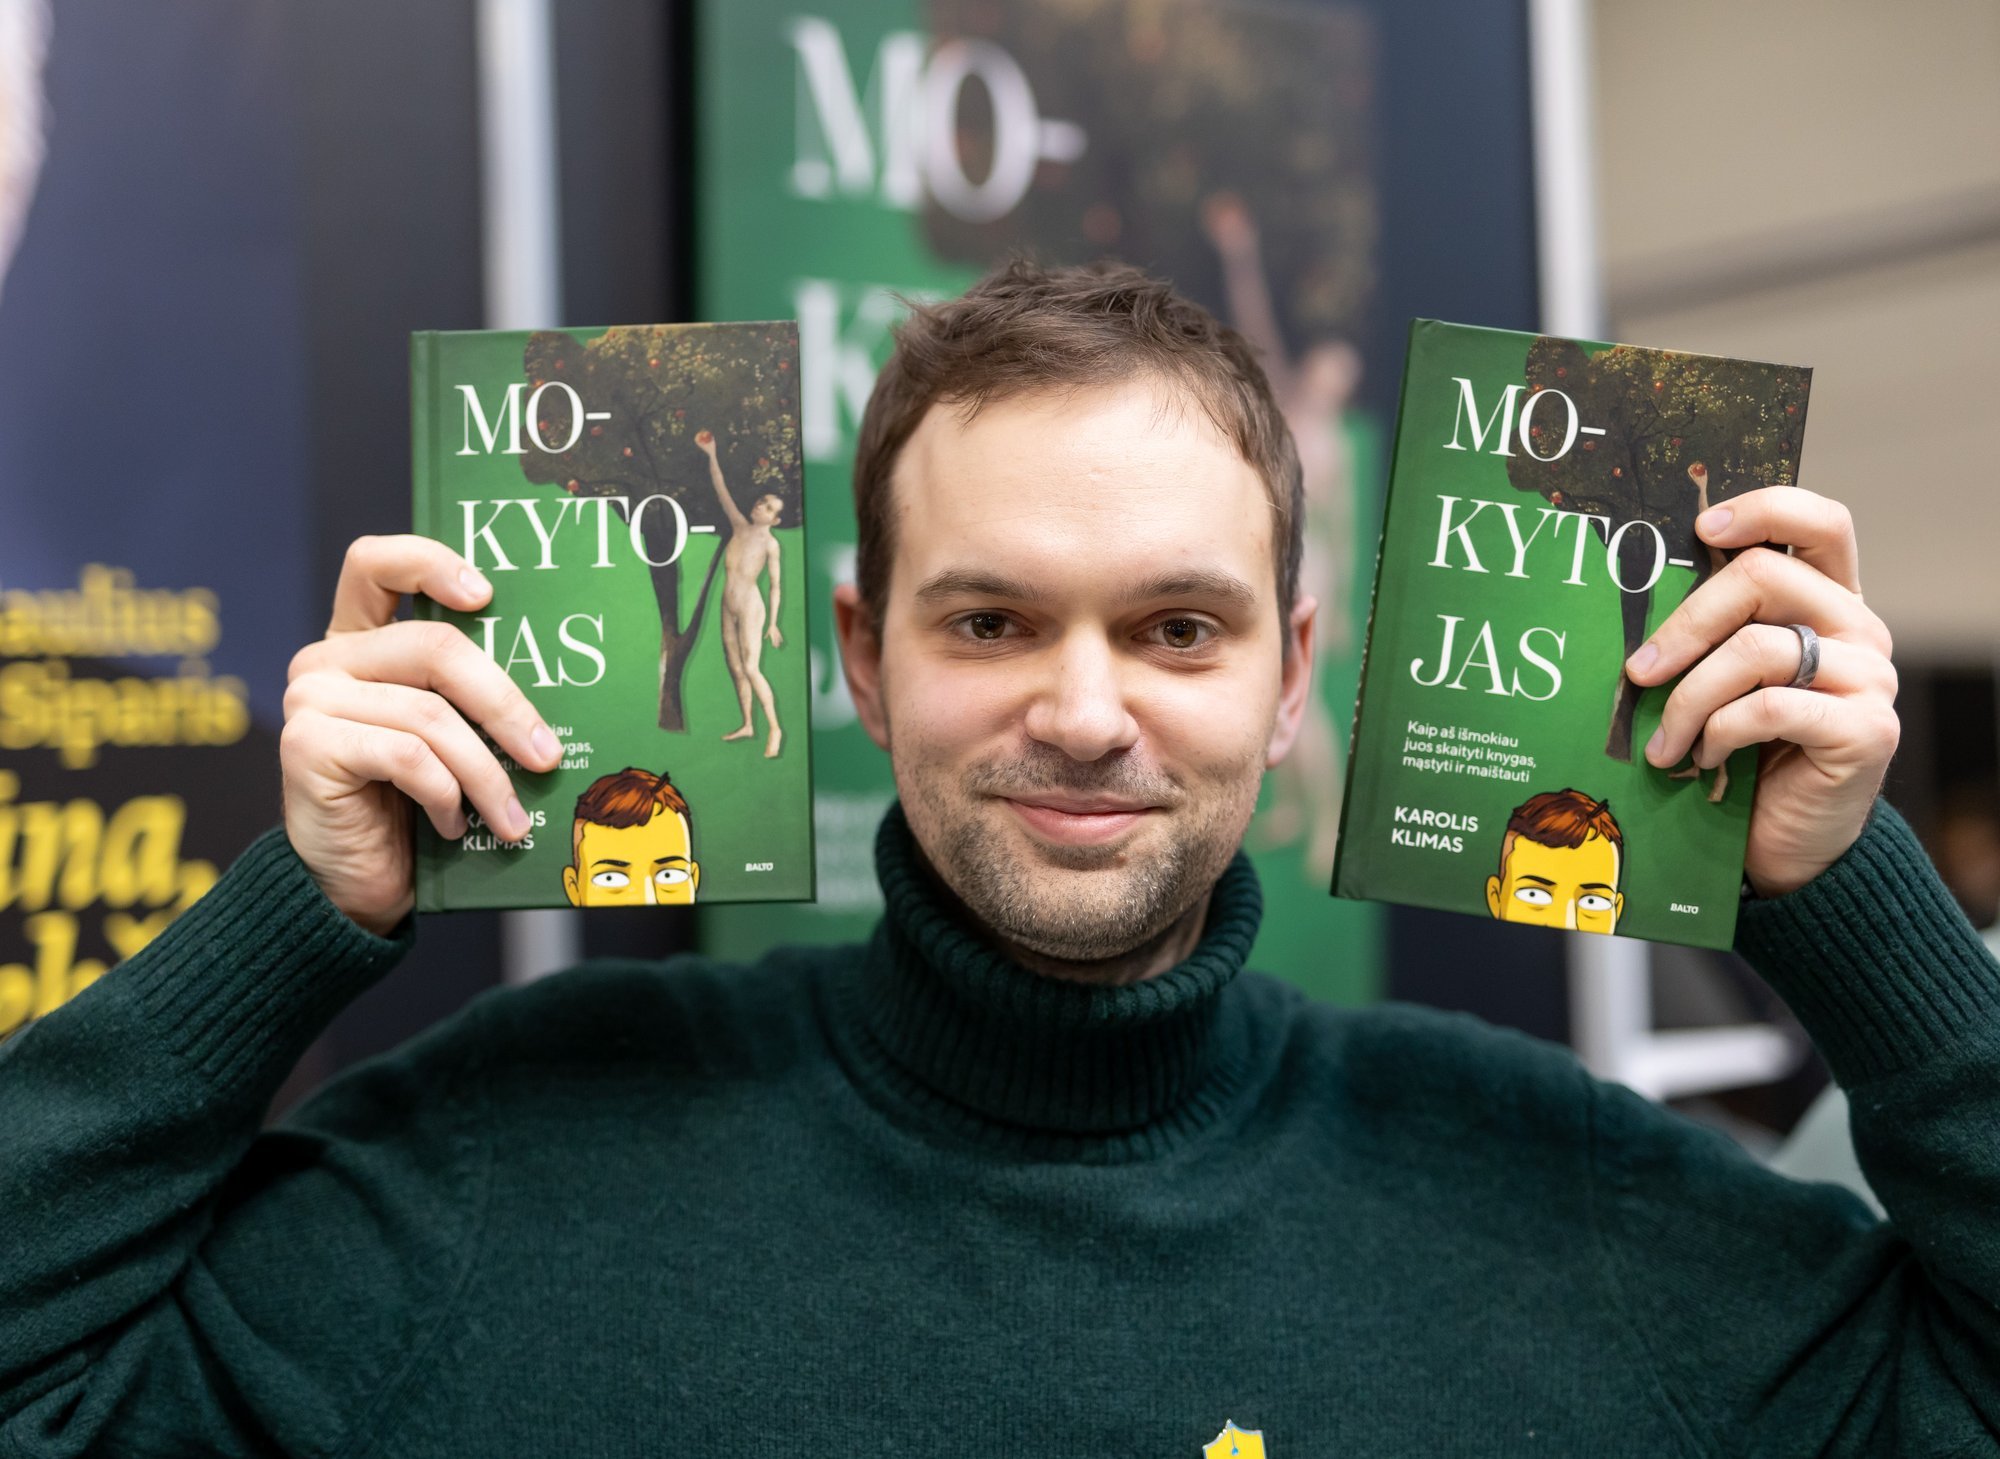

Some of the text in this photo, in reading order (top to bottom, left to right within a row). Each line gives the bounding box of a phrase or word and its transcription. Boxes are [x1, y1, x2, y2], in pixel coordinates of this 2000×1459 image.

[455, 381, 611, 456] MO-
[1442, 376, 1606, 462] MO-
[457, 494, 715, 571] KYTO-
[1427, 494, 1694, 594] KYTO-
[1410, 614, 1567, 701] JAS
[1407, 720, 1519, 748] Kaip aš išmokiau
[1403, 737, 1537, 769] juos skaityti knygas,
[1403, 755, 1530, 783] mąstyti ir maištauti
[1394, 805, 1479, 833] KAROLIS
[1391, 828, 1464, 853] KLIMAS
[745, 862, 774, 872] BALTO
[1670, 902, 1699, 914] BALTO
